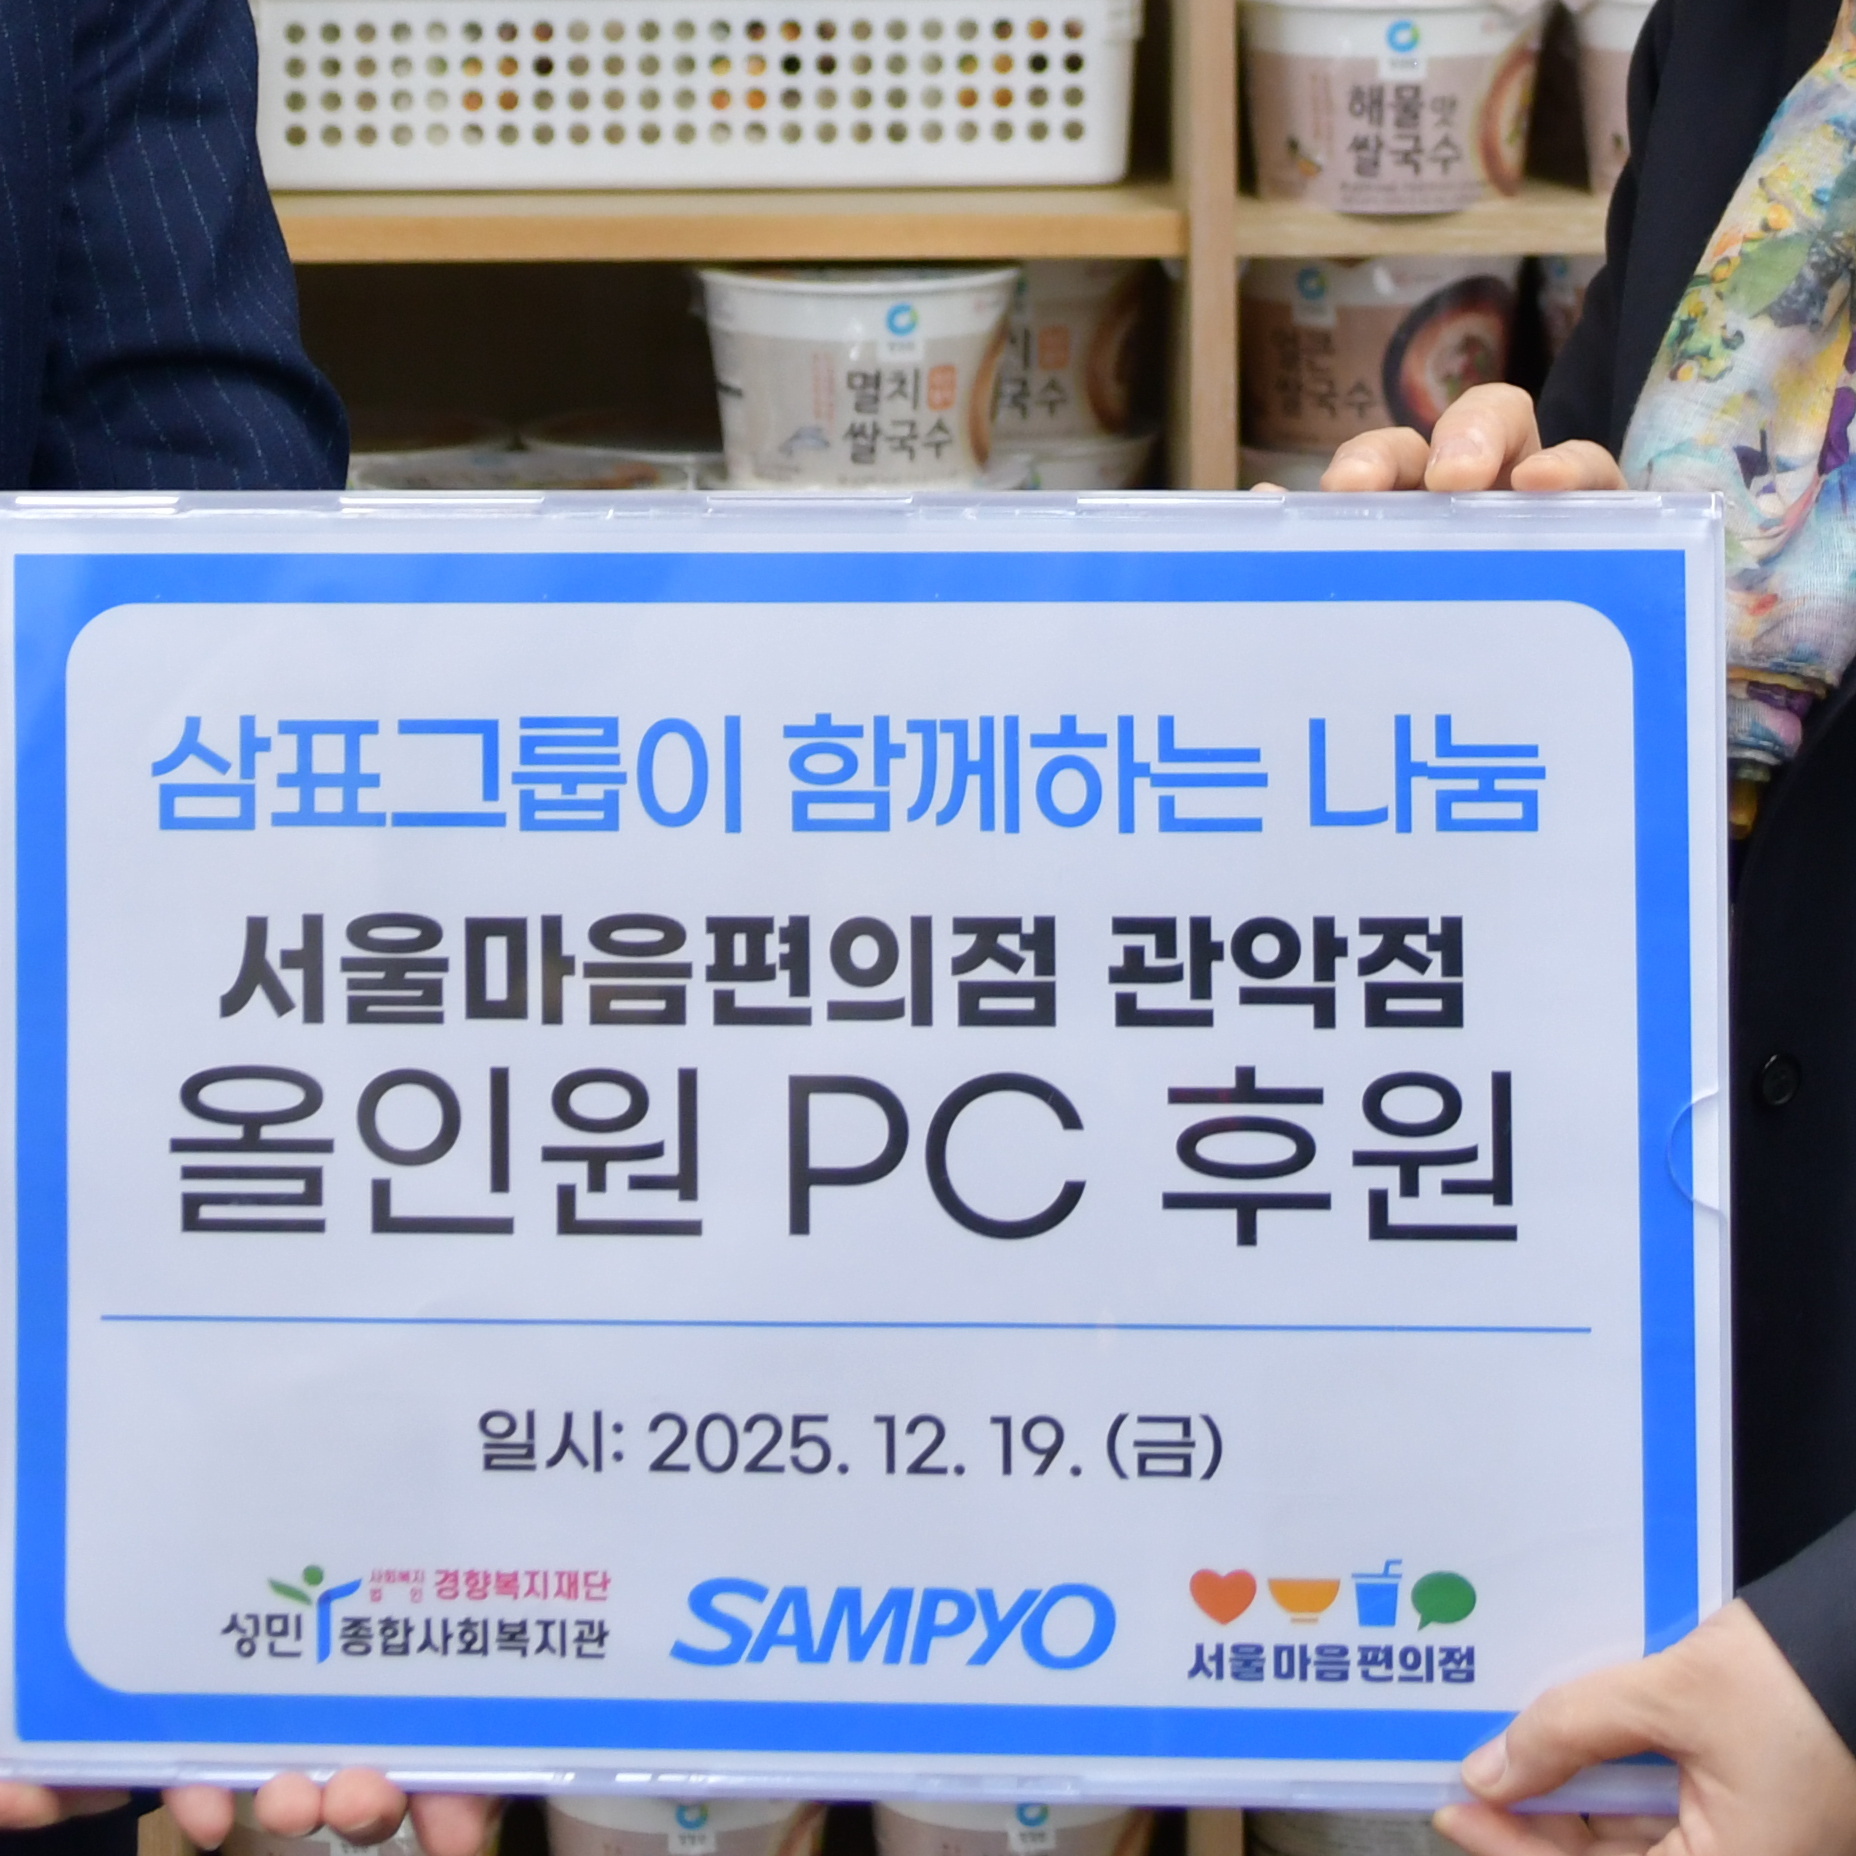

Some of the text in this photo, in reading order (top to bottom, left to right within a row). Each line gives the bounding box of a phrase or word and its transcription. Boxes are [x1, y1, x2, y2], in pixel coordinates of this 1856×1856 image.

[1347, 132, 1463, 180] 쌀국수
[846, 369, 921, 414] 멸치
[842, 418, 953, 466] 쌀국수
[150, 712, 1548, 835] 삼표그룹이 함께하는 나눔
[219, 911, 1465, 1030] 서울마음편의점 관악점
[167, 1063, 1519, 1248] 올인원 PC 후원
[477, 1408, 1224, 1481] 일시: 2025. 12. 19. (금)
[435, 1568, 612, 1602] 경향복지재단
[220, 1612, 611, 1660] 성민 종합사회복지관
[670, 1576, 1117, 1672] SAMPYO
